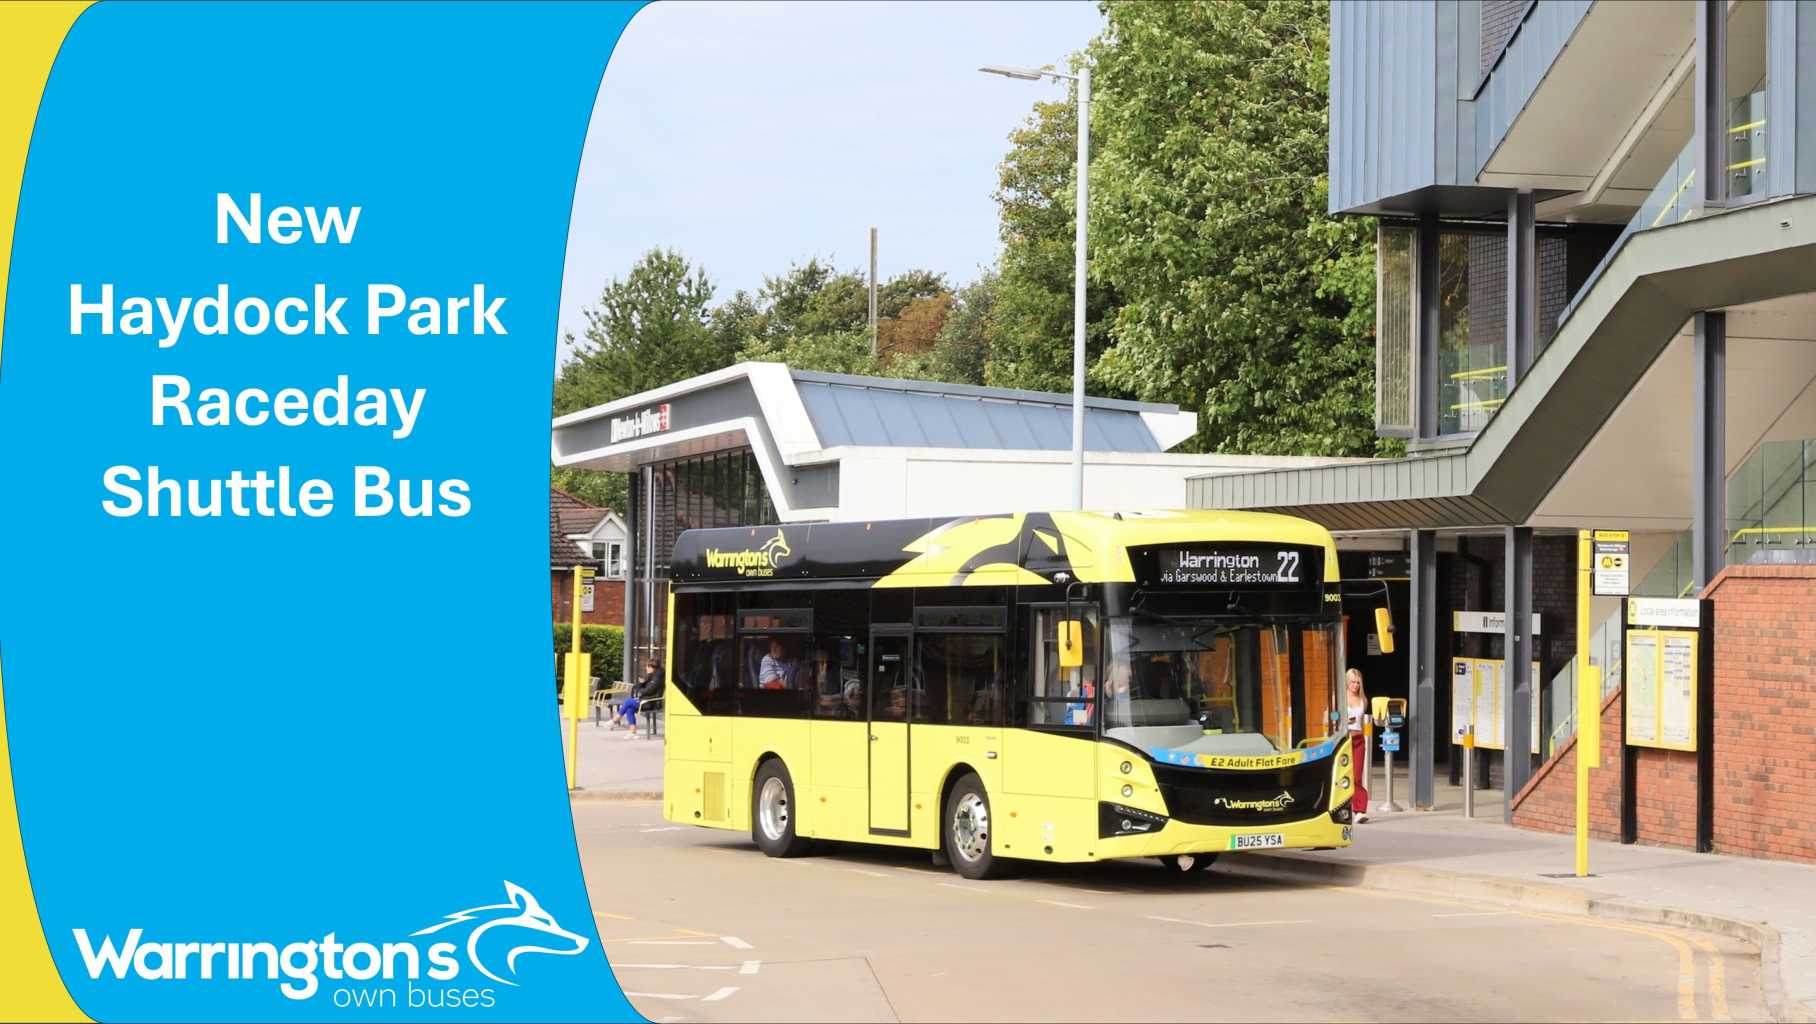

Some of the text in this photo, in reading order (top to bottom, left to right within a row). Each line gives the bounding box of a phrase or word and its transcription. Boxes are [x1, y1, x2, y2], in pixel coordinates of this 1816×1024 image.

[1180, 551, 1259, 568] Warrington
[1277, 551, 1299, 582] 22
[1160, 569, 1278, 582] via Garswood & Earlestown
[1227, 758, 1254, 767] Adult
[1255, 757, 1275, 767] Flat
[1276, 756, 1296, 766] Fare
[1237, 834, 1282, 848] BU25 YSA
